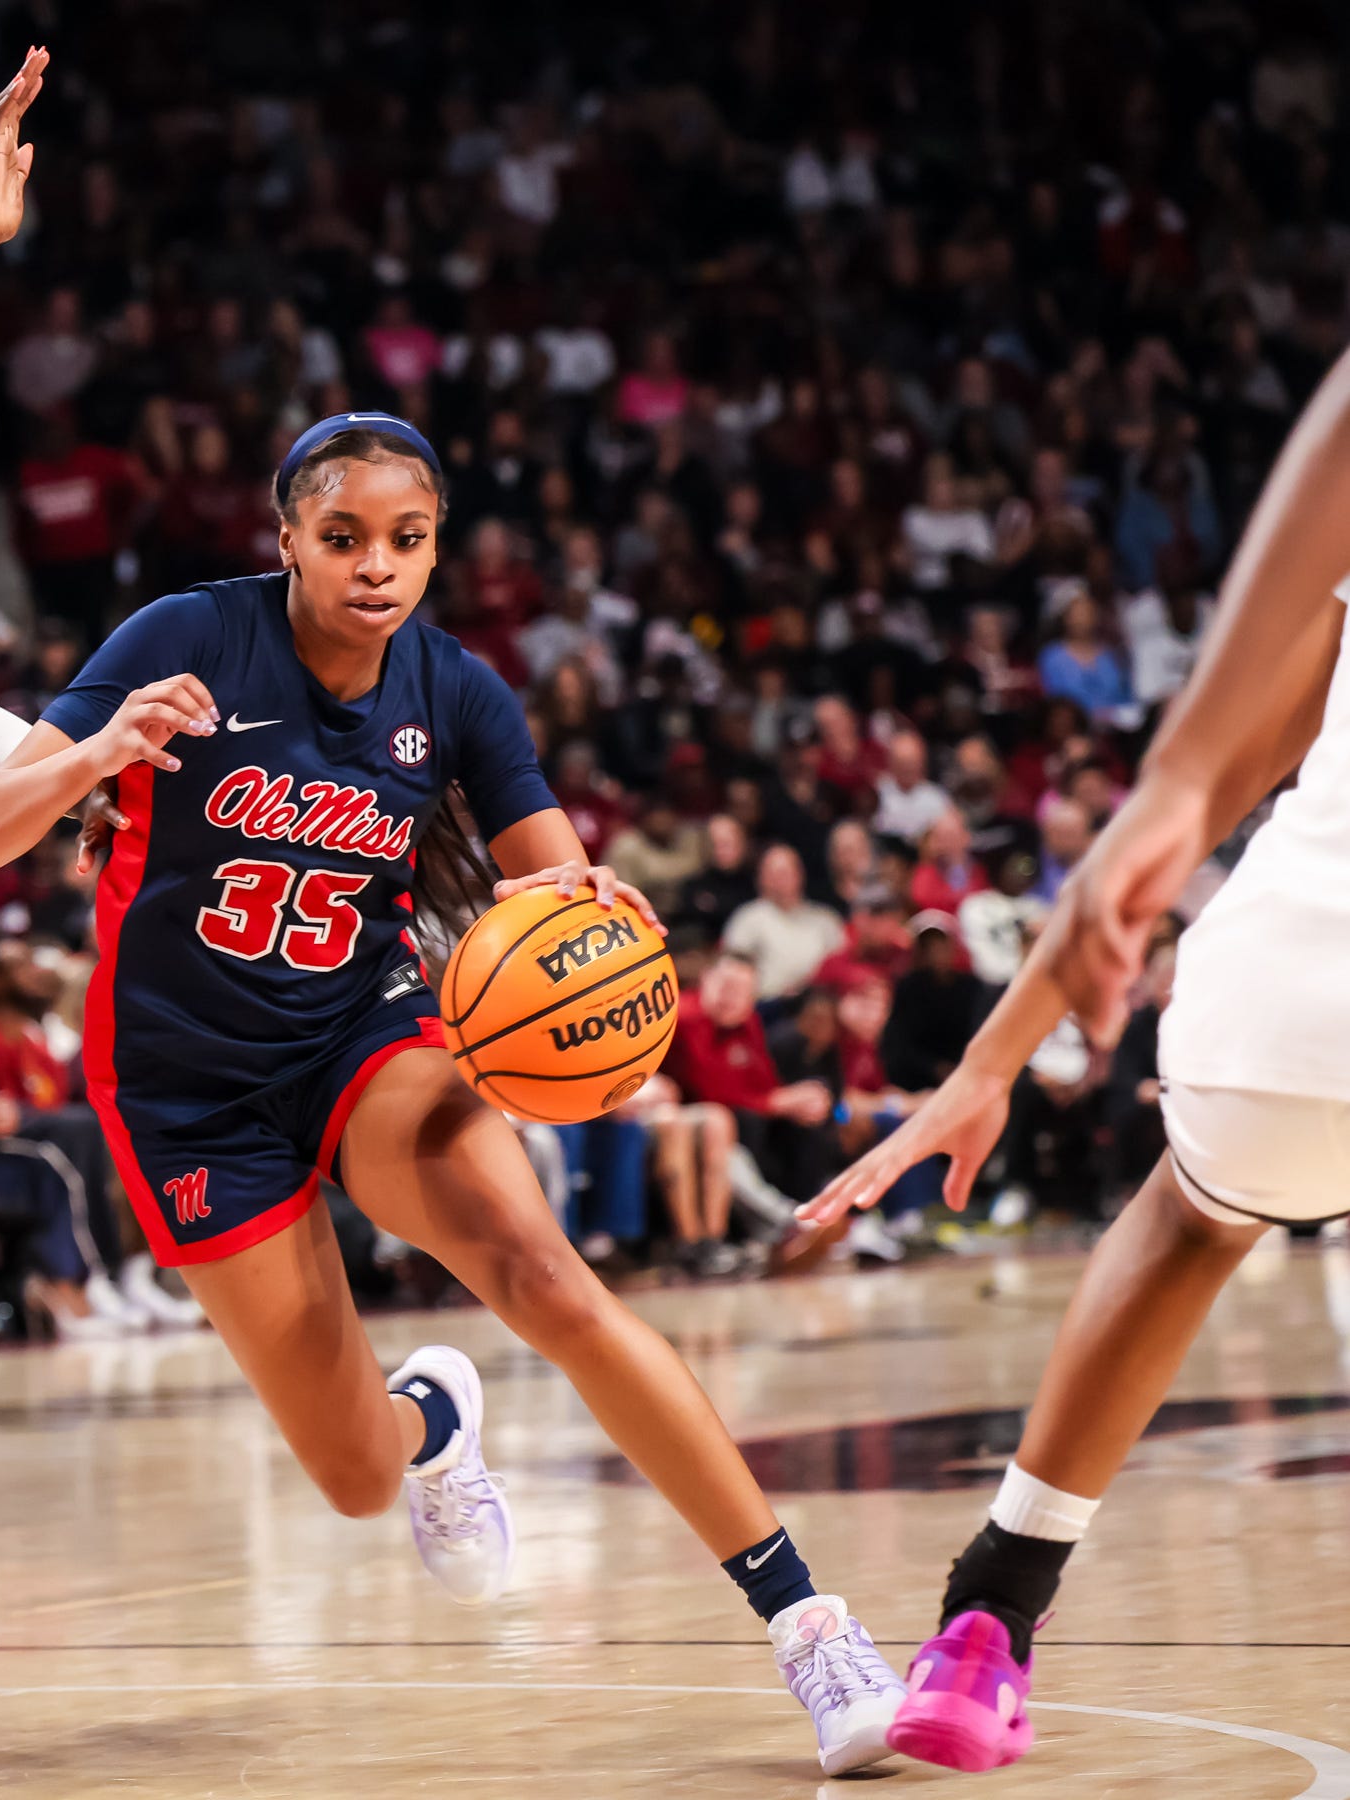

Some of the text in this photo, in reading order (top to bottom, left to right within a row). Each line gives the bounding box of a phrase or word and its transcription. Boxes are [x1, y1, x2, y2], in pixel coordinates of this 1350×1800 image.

[393, 727, 428, 764] SEC
[204, 765, 415, 861] Ole Miss
[195, 857, 375, 973] 35
[536, 915, 640, 984] NCAA
[548, 971, 675, 1052] Wilson
